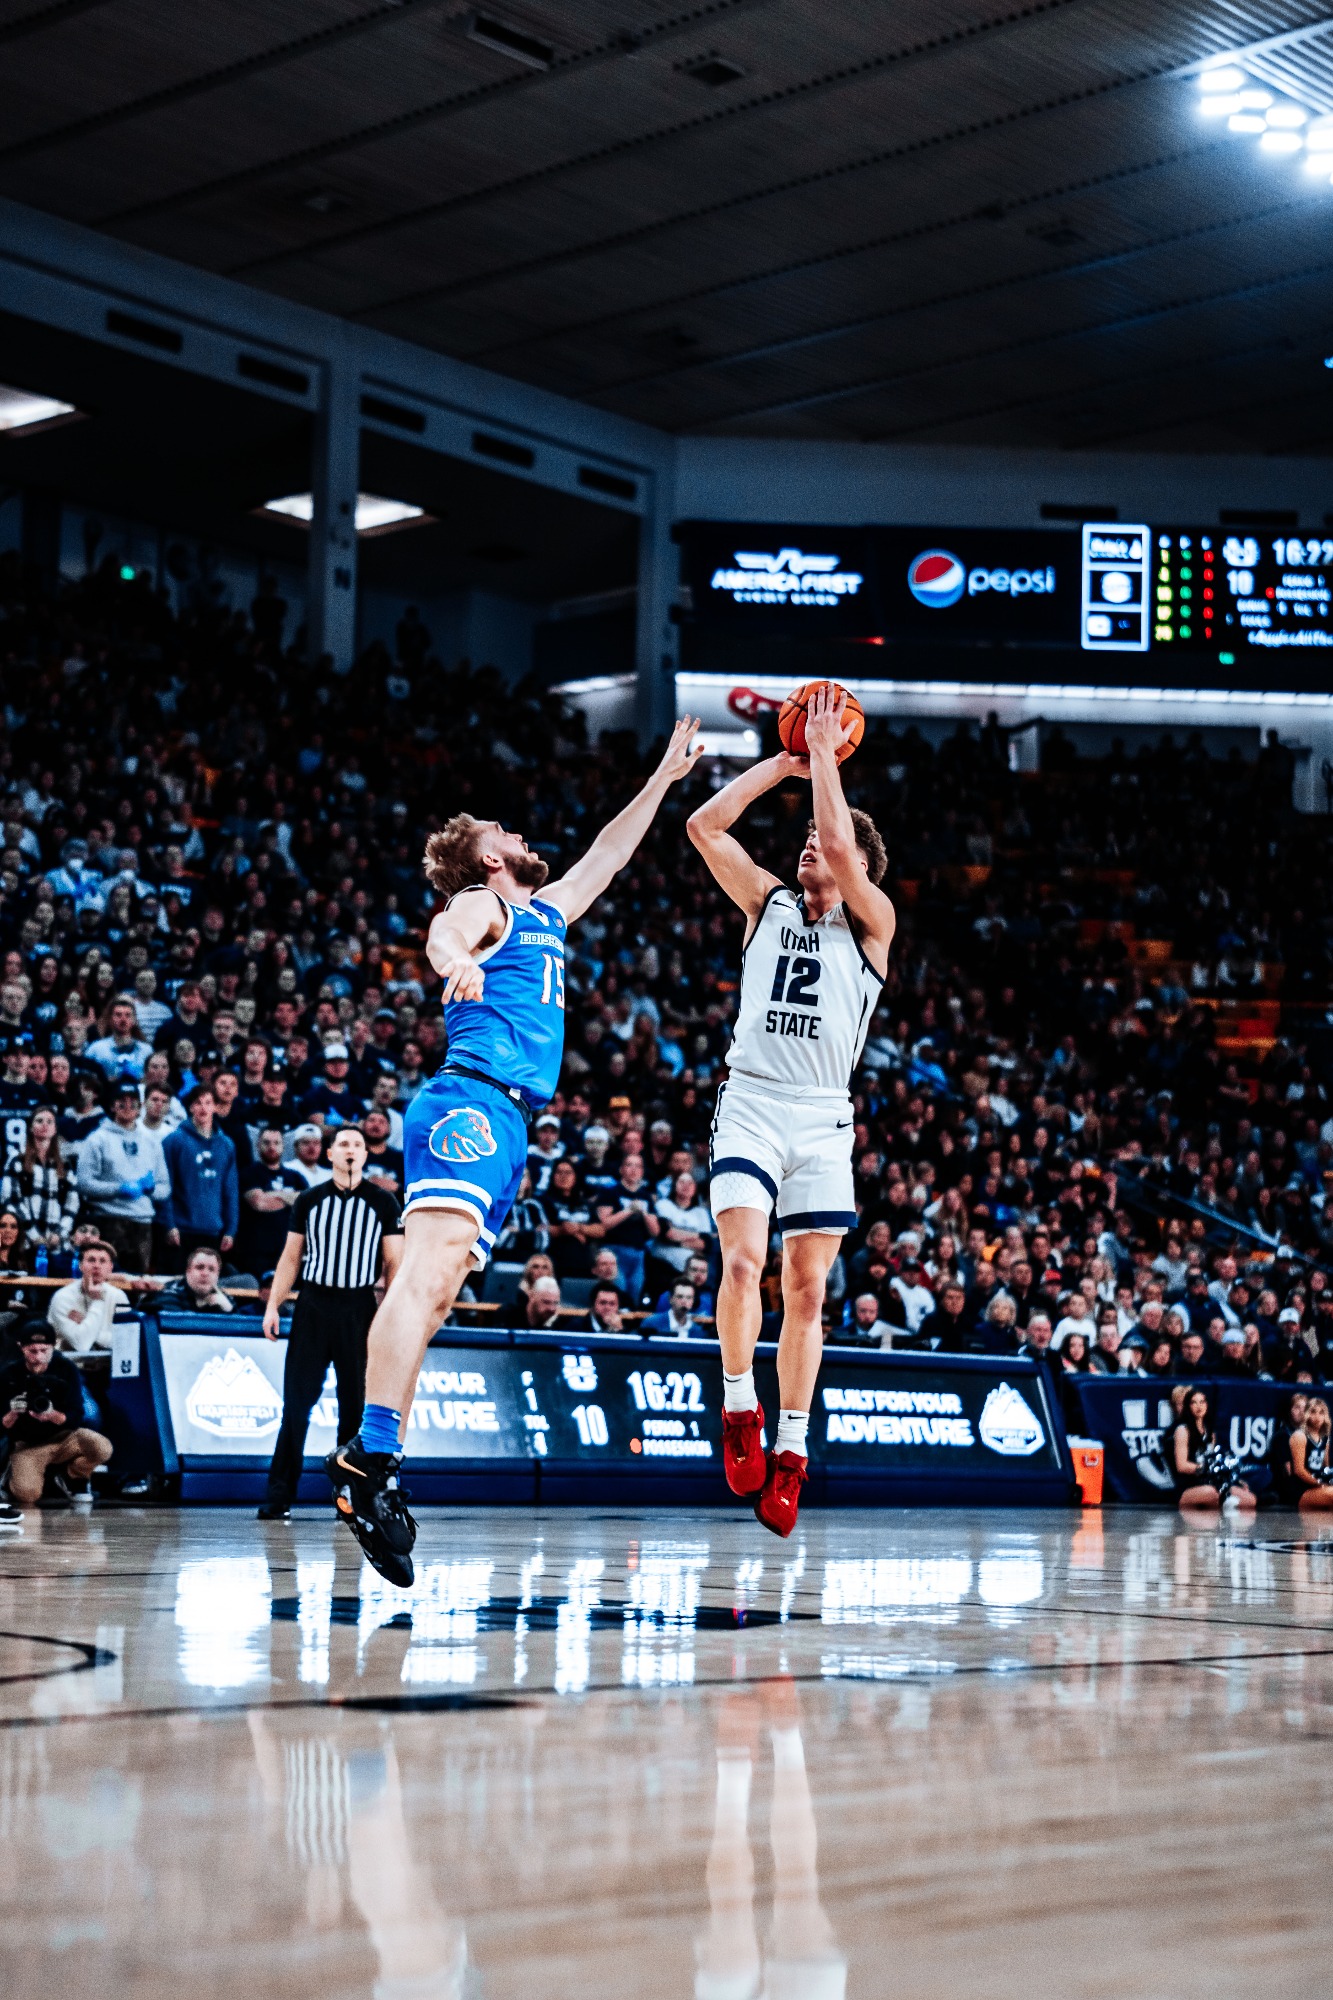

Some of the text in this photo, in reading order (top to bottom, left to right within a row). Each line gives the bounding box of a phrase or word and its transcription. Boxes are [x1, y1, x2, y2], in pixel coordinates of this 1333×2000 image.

[968, 567, 1056, 597] pepsi
[781, 926, 820, 953] UTAH
[770, 955, 821, 1007] 12
[766, 1010, 822, 1040] STATE
[419, 1371, 487, 1395] YOUR
[627, 1371, 706, 1412] 16:22
[823, 1389, 962, 1414] BUILT FOR YOUR
[571, 1404, 609, 1446] 10
[642, 1420, 686, 1437] PERIOD
[827, 1414, 974, 1446] ADVENTURE
[1230, 1416, 1276, 1458] US
